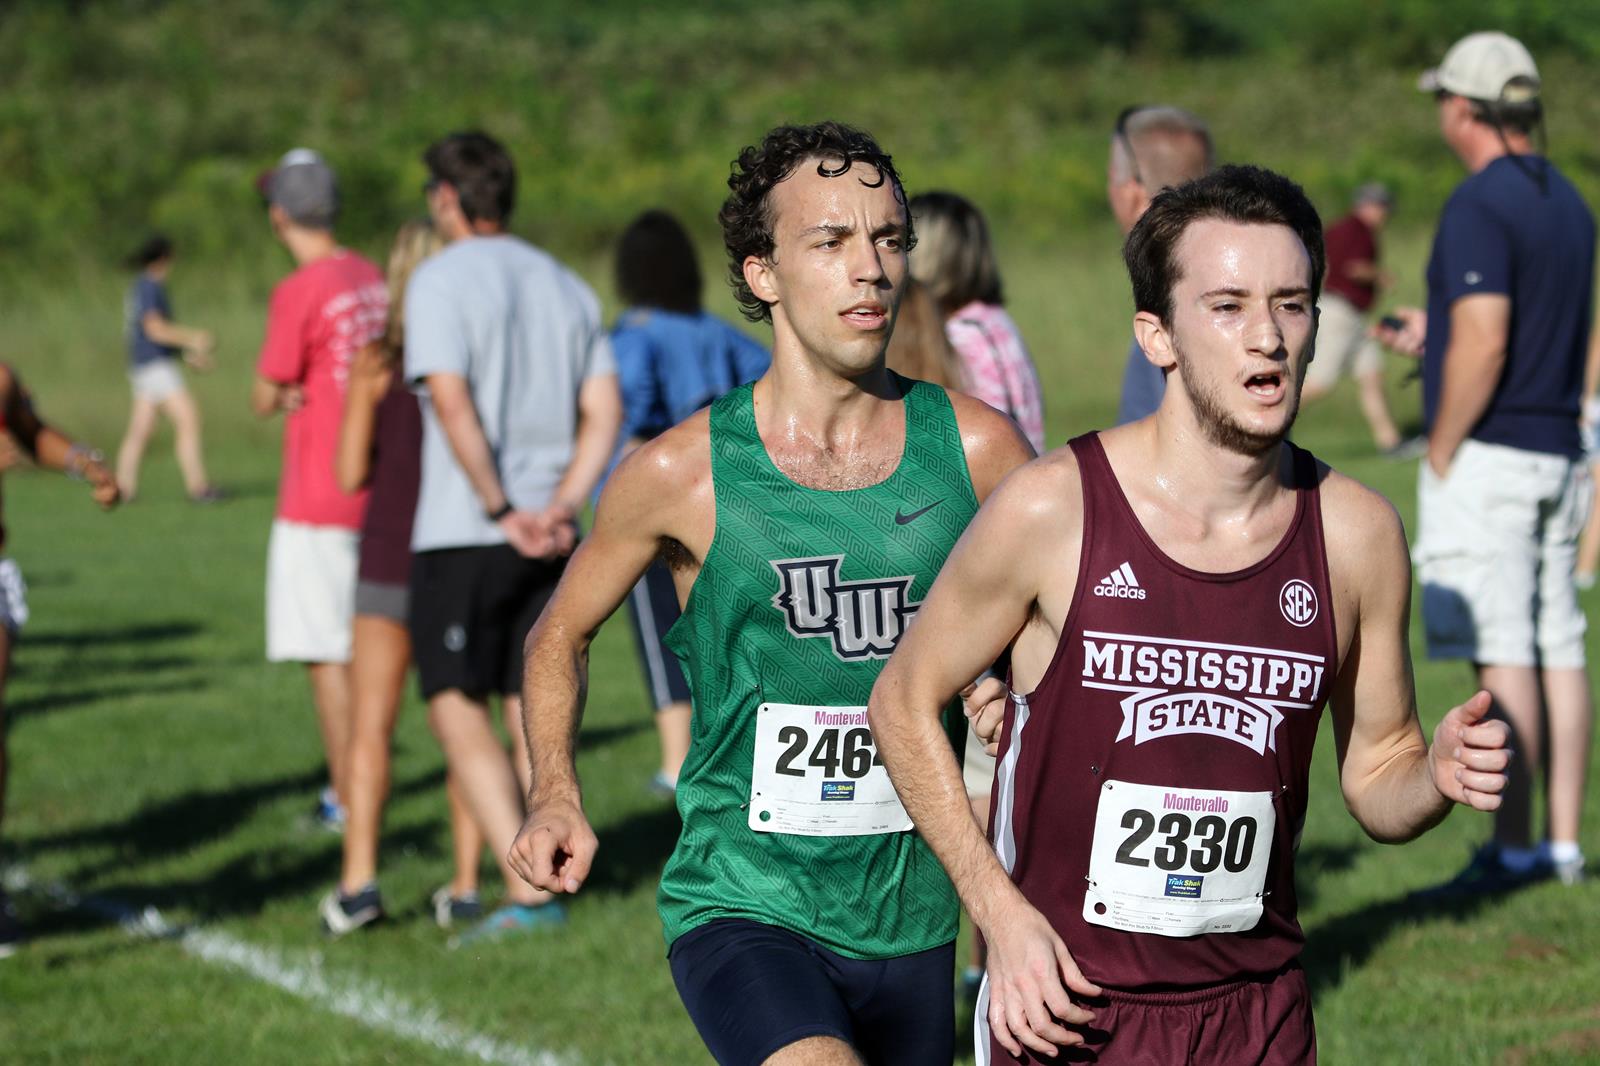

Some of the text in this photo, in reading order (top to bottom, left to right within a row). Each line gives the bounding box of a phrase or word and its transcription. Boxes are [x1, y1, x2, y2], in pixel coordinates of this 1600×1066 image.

[769, 554, 923, 662] UW
[1093, 583, 1146, 600] adidas
[1284, 584, 1313, 622] SEC
[1082, 640, 1325, 702] MISSISSIPPI
[1148, 699, 1258, 742] STATE
[1163, 792, 1229, 813] Montevallo
[1114, 808, 1257, 873] 2330
[1168, 878, 1184, 886] Trak
